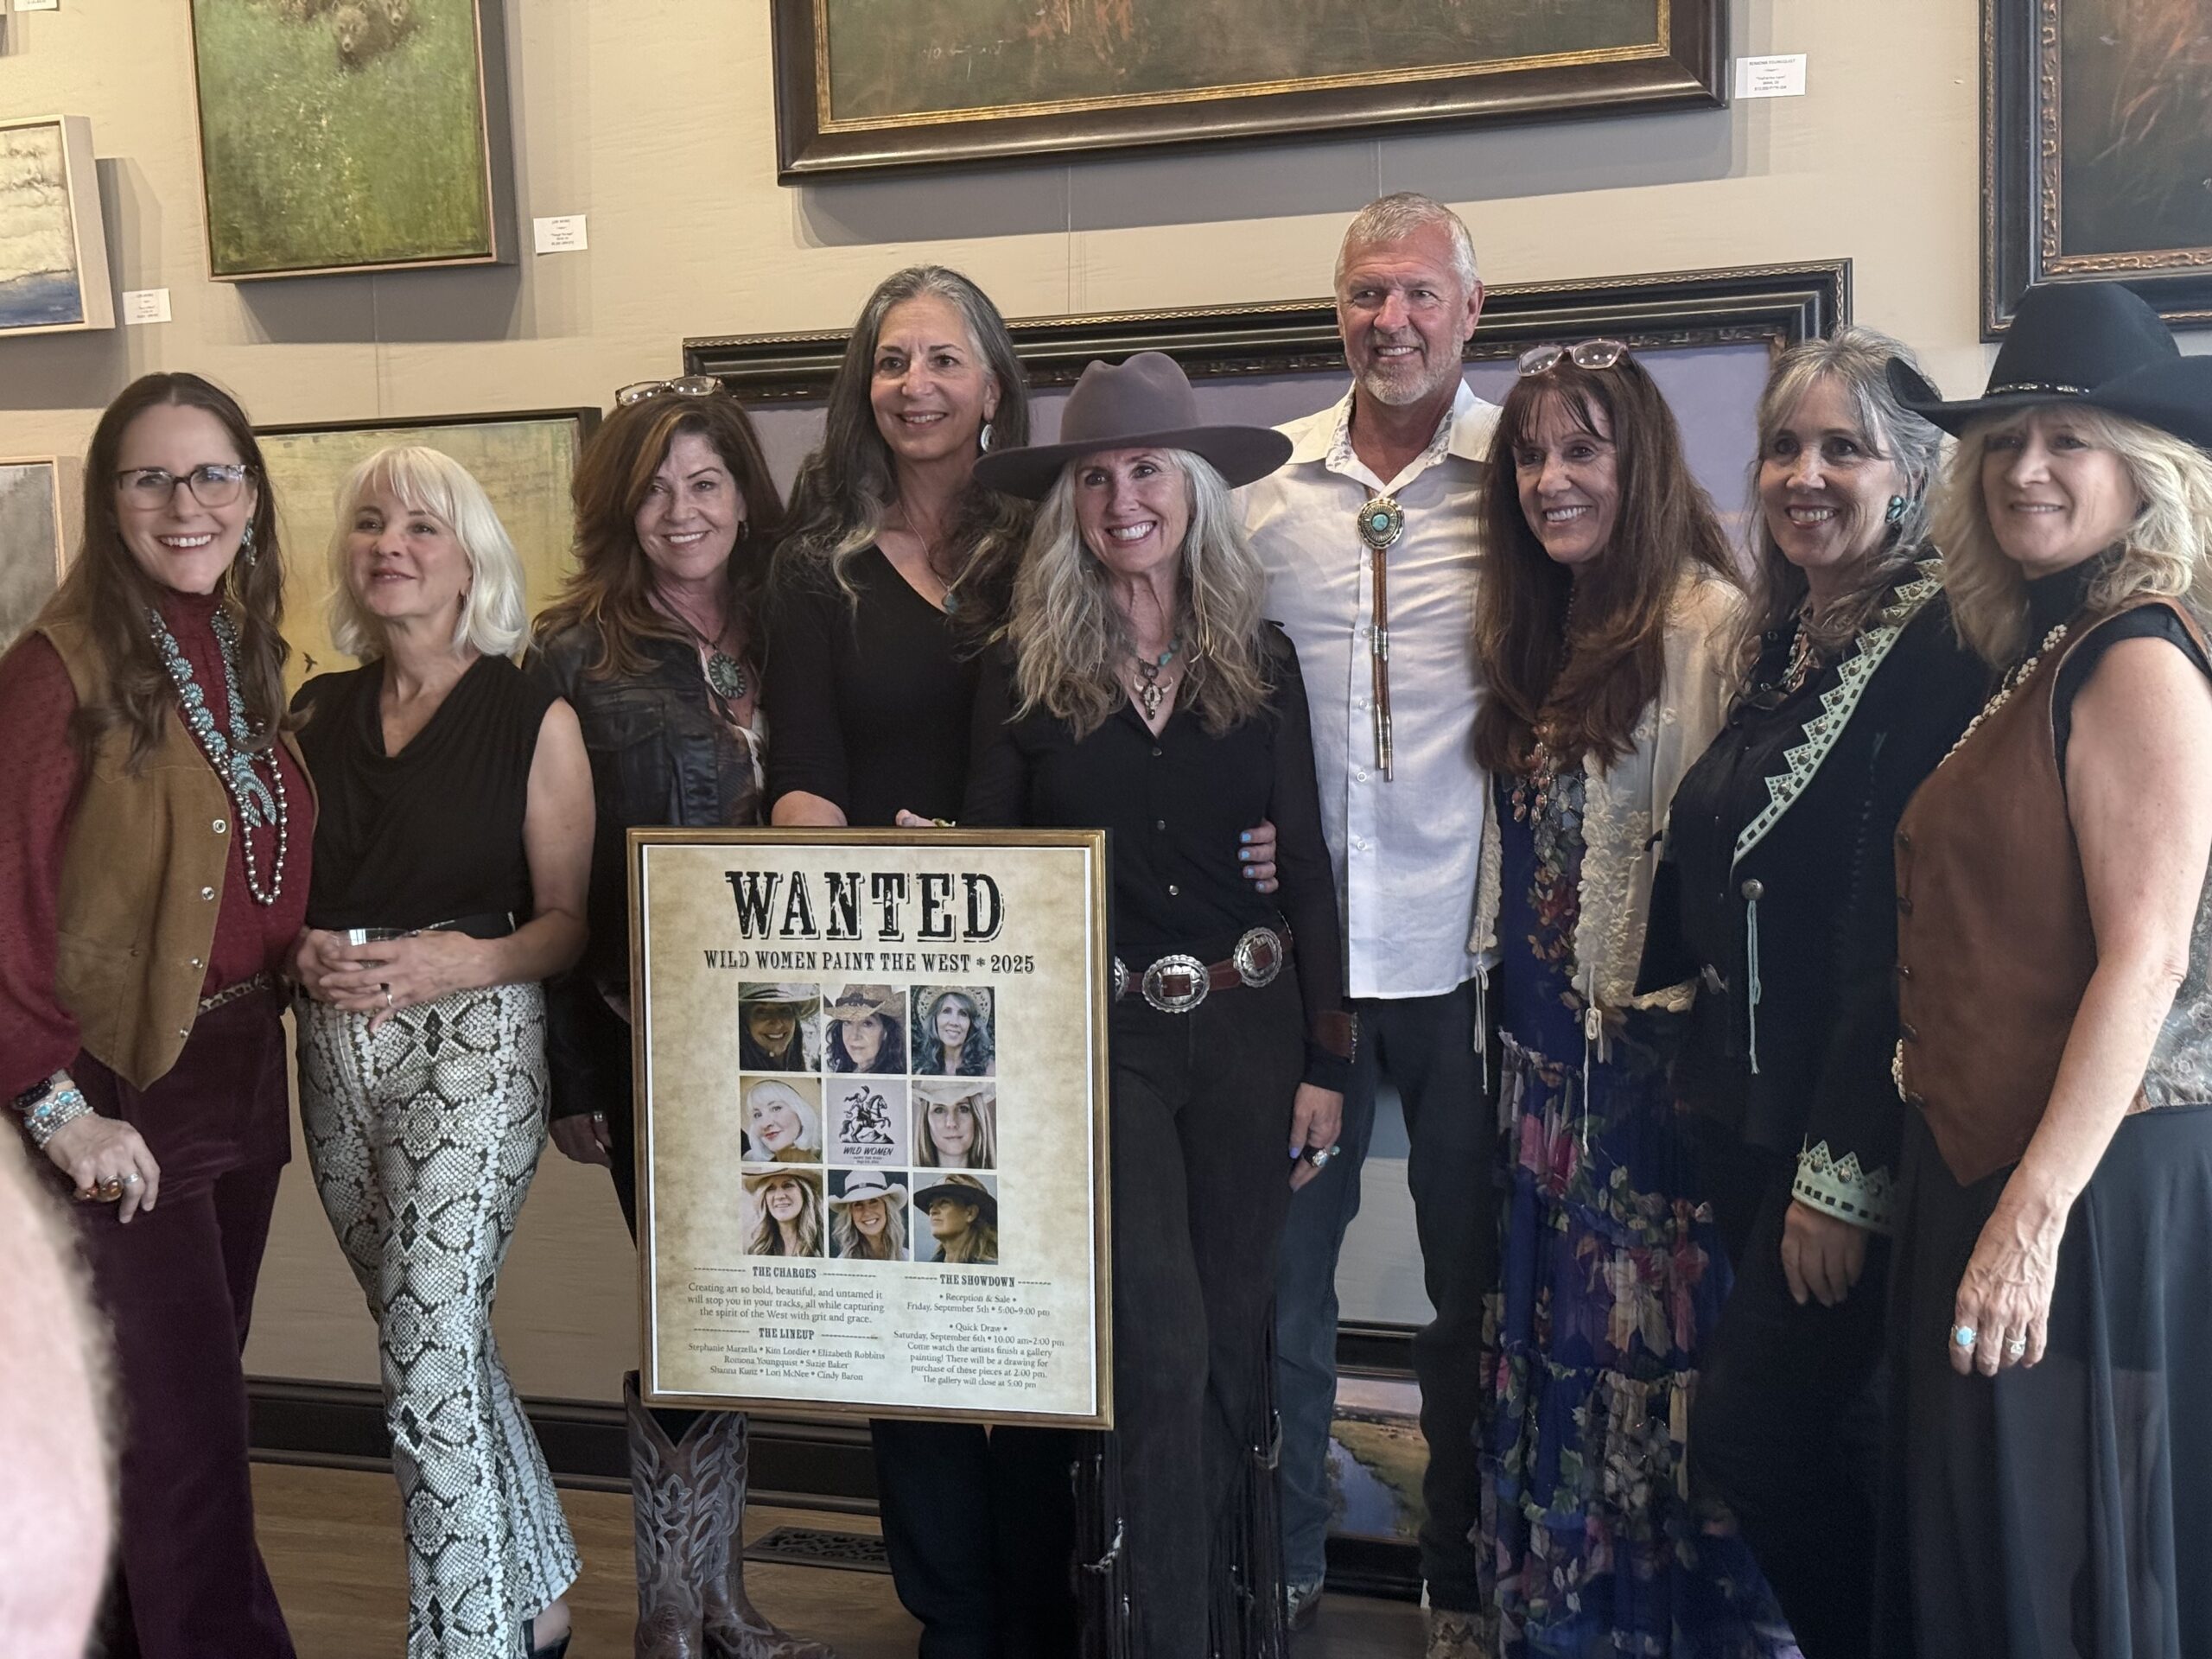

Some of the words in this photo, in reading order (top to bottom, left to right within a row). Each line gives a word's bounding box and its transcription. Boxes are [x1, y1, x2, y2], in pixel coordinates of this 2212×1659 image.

[724, 870, 1006, 943] WANTED
[704, 950, 749, 969] WILD
[756, 950, 817, 970] WOMEN
[823, 952, 875, 971] PAINT
[880, 952, 916, 971] THE
[921, 953, 971, 973] WEST
[990, 954, 1036, 974] 2025
[843, 1147, 862, 1155] WILD
[864, 1147, 894, 1156] WOMEN
[752, 1266, 772, 1277] THE
[773, 1267, 817, 1279] CHARGES
[939, 1274, 959, 1285] THE
[961, 1275, 1015, 1287] SHOWDOWN
[688, 1282, 724, 1294] Creating
[753, 1285, 773, 1294] bold,
[776, 1287, 816, 1297] beautiful,
[818, 1288, 834, 1297] and
[836, 1290, 874, 1299] untamed
[876, 1290, 882, 1300] it
[945, 1292, 983, 1303] Reception
[995, 1294, 1011, 1303] Sale
[687, 1294, 703, 1304] will
[705, 1296, 724, 1306] stop
[725, 1298, 741, 1306] you
[743, 1296, 752, 1305] in
[753, 1299, 772, 1307] your
[775, 1299, 804, 1309] tracks,
[806, 1300, 817, 1309] all
[818, 1300, 842, 1310] while
[843, 1302, 885, 1314] capturing
[906, 1301, 932, 1313] Friday,
[934, 1302, 974, 1313] September
[976, 1305, 989, 1313] 5th
[1037, 1309, 1051, 1318] pm
[700, 1306, 714, 1316] the
[715, 1308, 738, 1319] spirit
[740, 1308, 750, 1318] of
[750, 1309, 765, 1319] the
[766, 1309, 788, 1319] West
[790, 1311, 810, 1320] with
[811, 1312, 827, 1323] grit
[829, 1313, 845, 1322] and
[847, 1315, 873, 1325] grace.
[758, 1327, 779, 1338] THE
[779, 1328, 815, 1340] LINEUP
[955, 1322, 978, 1332] Quick
[981, 1323, 1001, 1332] Draw
[893, 1331, 928, 1341] Saturday,
[930, 1332, 970, 1342] September
[1051, 1339, 1065, 1348] pm
[688, 1343, 724, 1353] Stephanie
[726, 1344, 758, 1354] Marzella
[766, 1346, 781, 1355] Kim
[783, 1347, 810, 1357] Lordier
[817, 1348, 852, 1358] Elizabeth
[855, 1350, 886, 1360] Robbins
[907, 1341, 931, 1351] Come
[956, 1344, 969, 1353] the
[996, 1345, 1018, 1355] finish
[1027, 1348, 1052, 1358] gallery
[756, 1357, 798, 1368] Youngquist
[805, 1359, 827, 1369] Suzie
[828, 1360, 849, 1370] Baker
[910, 1353, 944, 1363] painting!
[945, 1354, 969, 1363] There
[969, 1356, 984, 1364] will
[986, 1356, 995, 1364] be
[1003, 1357, 1035, 1369] drawing
[1036, 1359, 1049, 1368] for
[709, 1365, 737, 1375] Shanna
[766, 1368, 781, 1377] Lori
[783, 1369, 810, 1378] McNee
[817, 1370, 839, 1382] Cindy
[842, 1372, 864, 1381] Baron
[911, 1363, 945, 1374] purchase
[946, 1364, 956, 1373] of
[957, 1365, 977, 1374] these
[978, 1367, 1002, 1376] pieces
[924, 1375, 937, 1383] The
[938, 1376, 962, 1386] gallery
[977, 1377, 996, 1386] close
